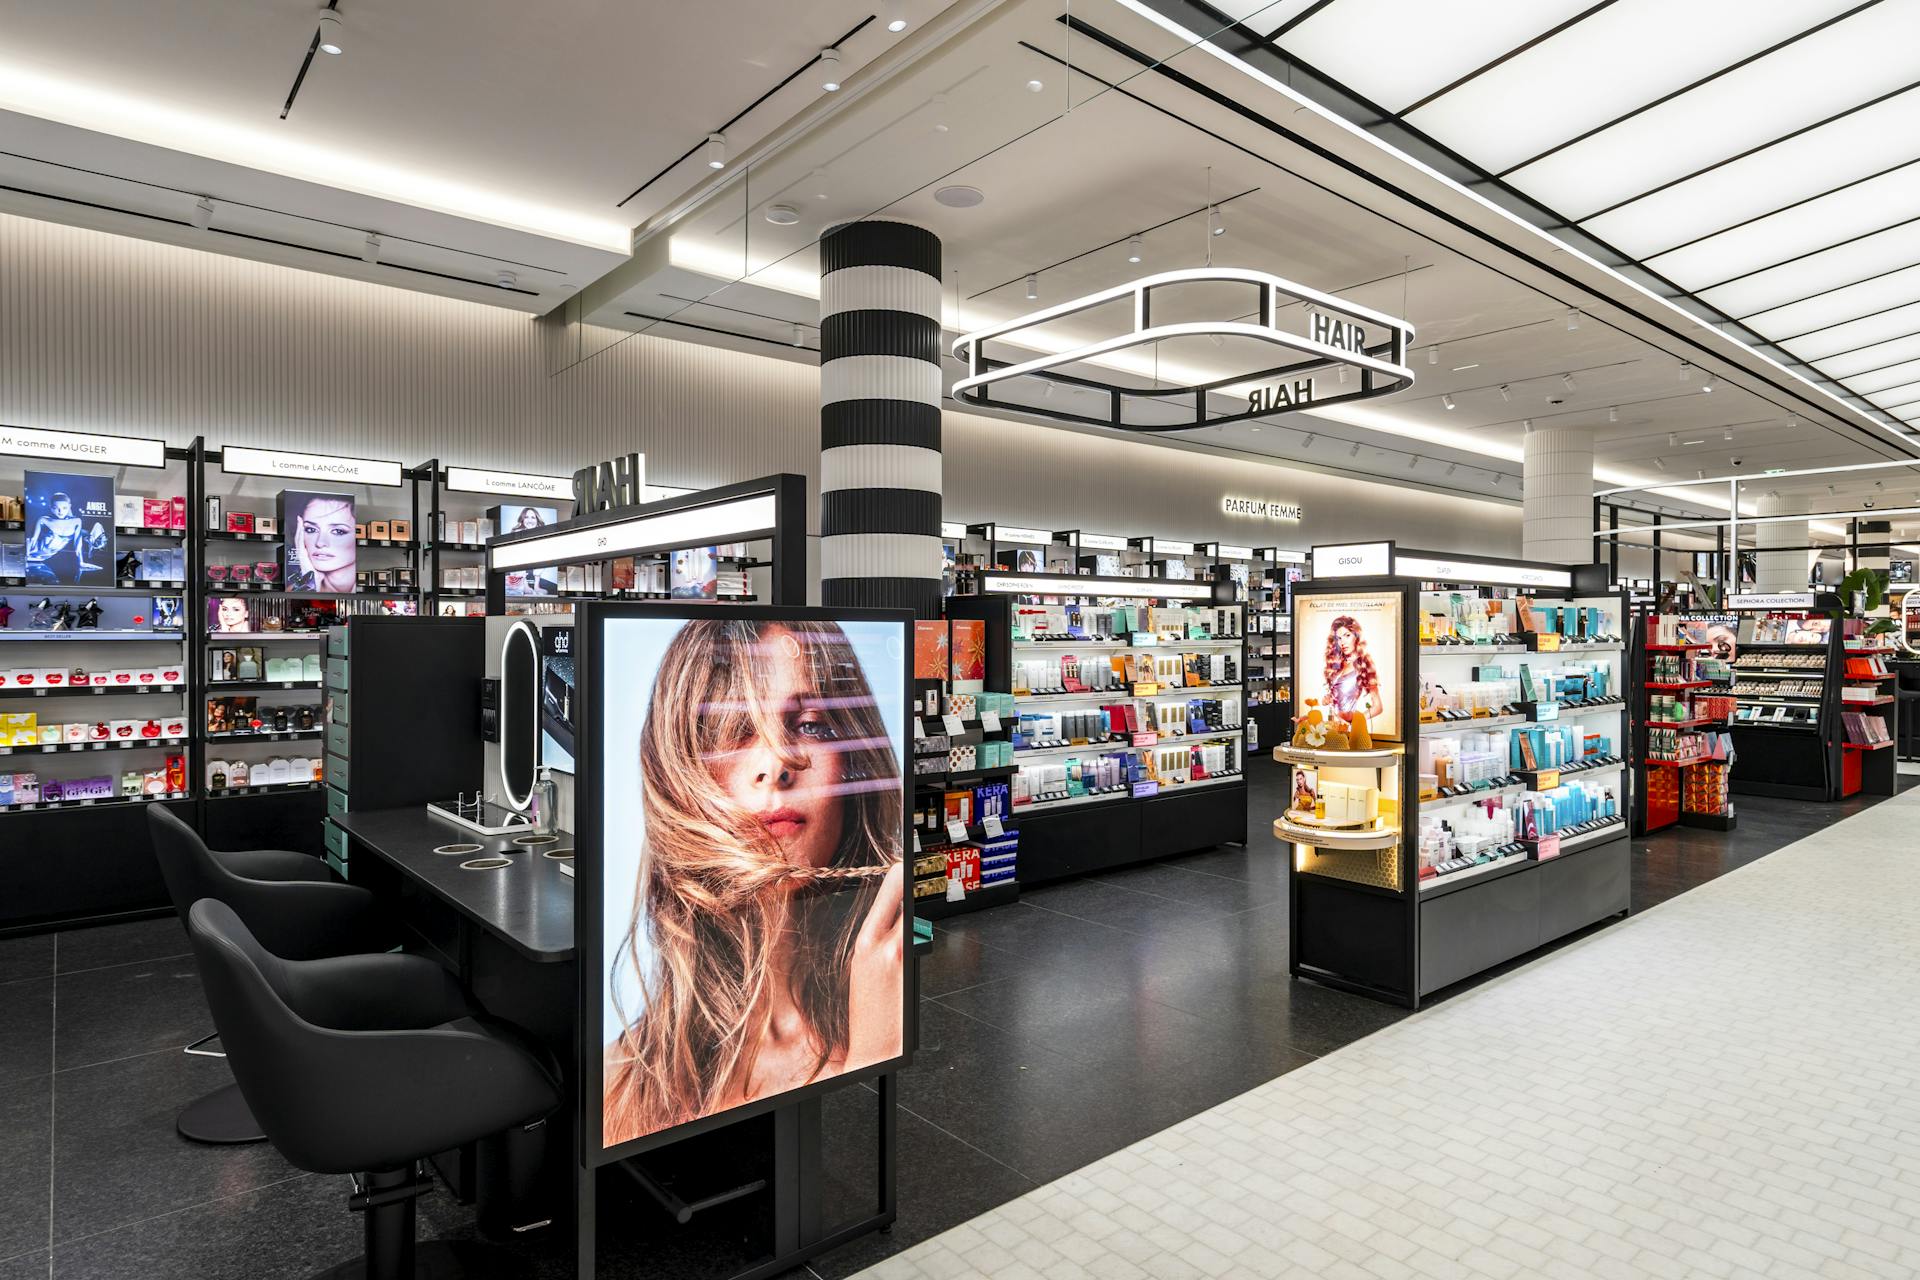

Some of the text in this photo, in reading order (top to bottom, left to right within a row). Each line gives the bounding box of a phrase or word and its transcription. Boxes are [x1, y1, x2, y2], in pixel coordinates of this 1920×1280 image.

[1311, 312, 1366, 356] HAIR
[1, 437, 108, 455] M comme MUGLER
[272, 460, 359, 475] L comme LANCÔME
[491, 480, 516, 488] comme
[518, 481, 556, 491] LANCÔME
[1225, 498, 1302, 520] PARFUM FEMME
[1338, 556, 1363, 565] GISOU
[554, 631, 569, 654] ghd
[977, 784, 1008, 798] KERA
[945, 849, 980, 863] KERA
